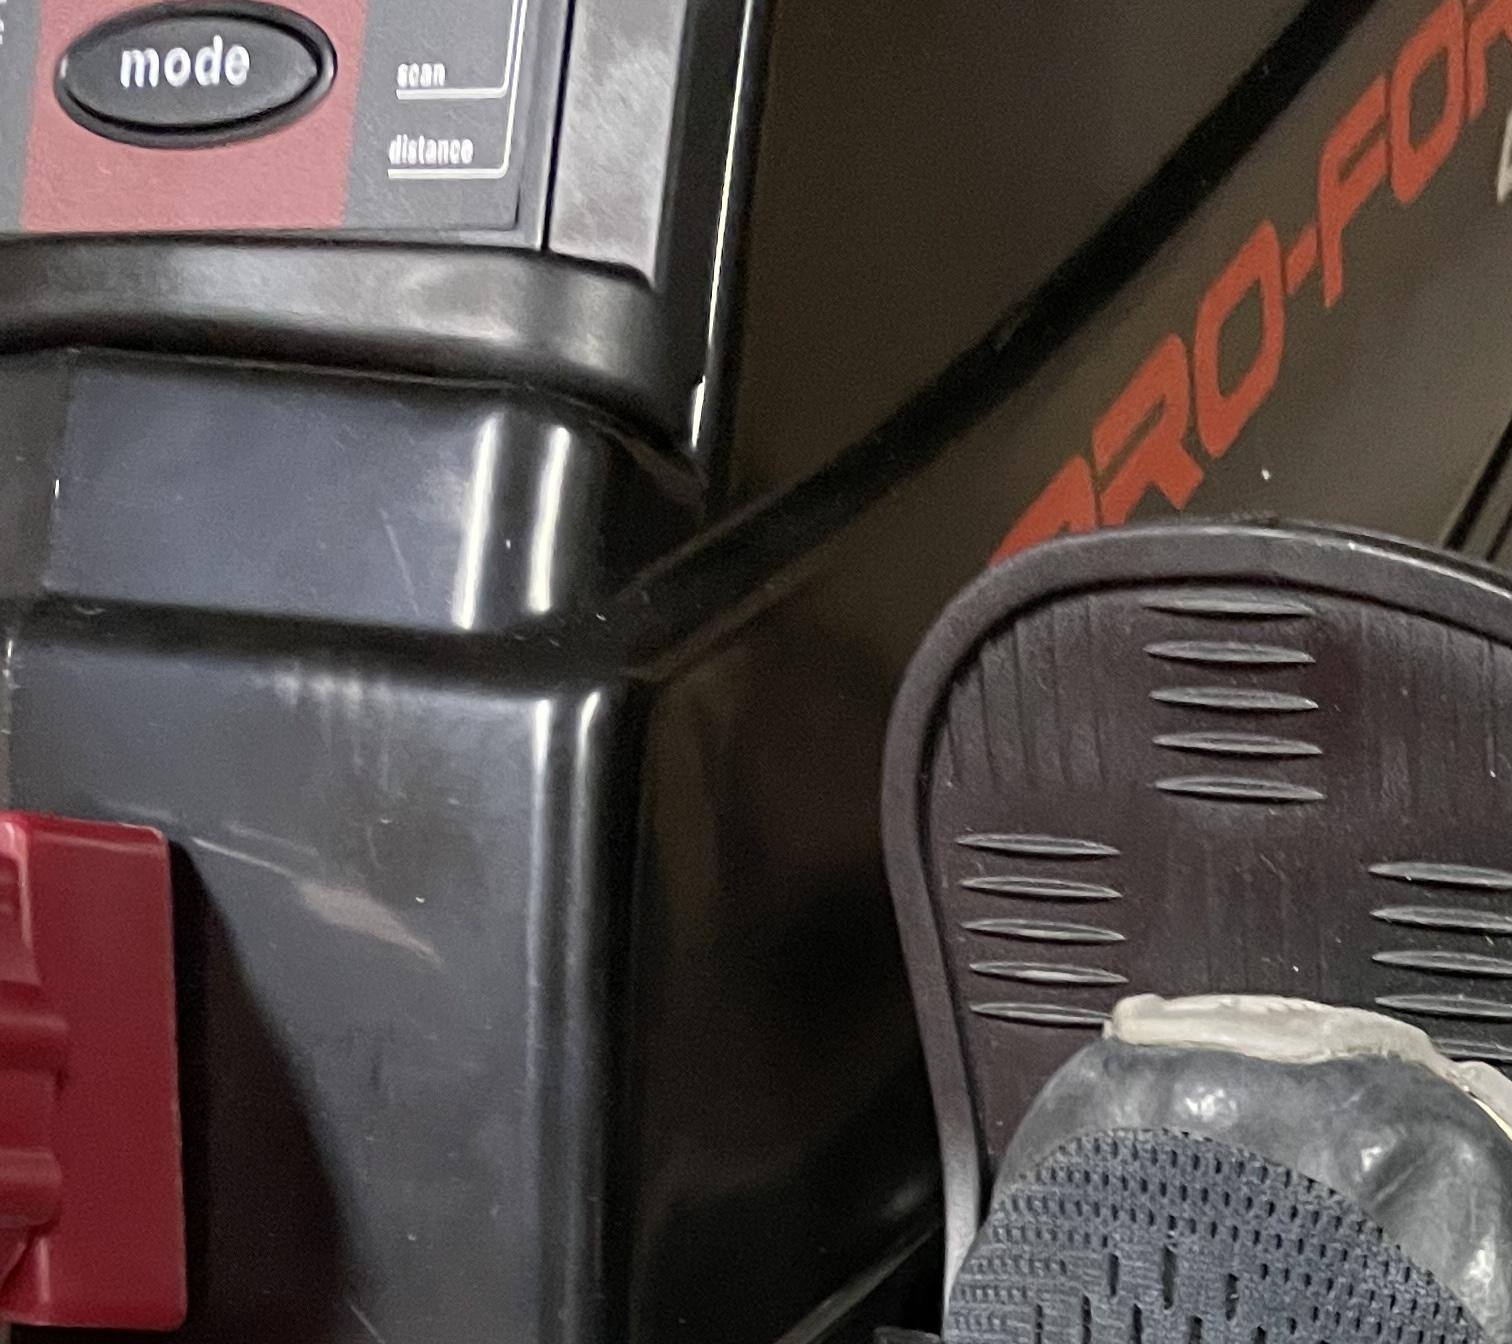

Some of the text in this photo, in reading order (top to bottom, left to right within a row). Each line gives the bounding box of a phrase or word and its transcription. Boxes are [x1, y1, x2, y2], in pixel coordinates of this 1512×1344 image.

[119, 35, 251, 89] mode
[397, 62, 446, 88] scan
[388, 133, 474, 165] distance
